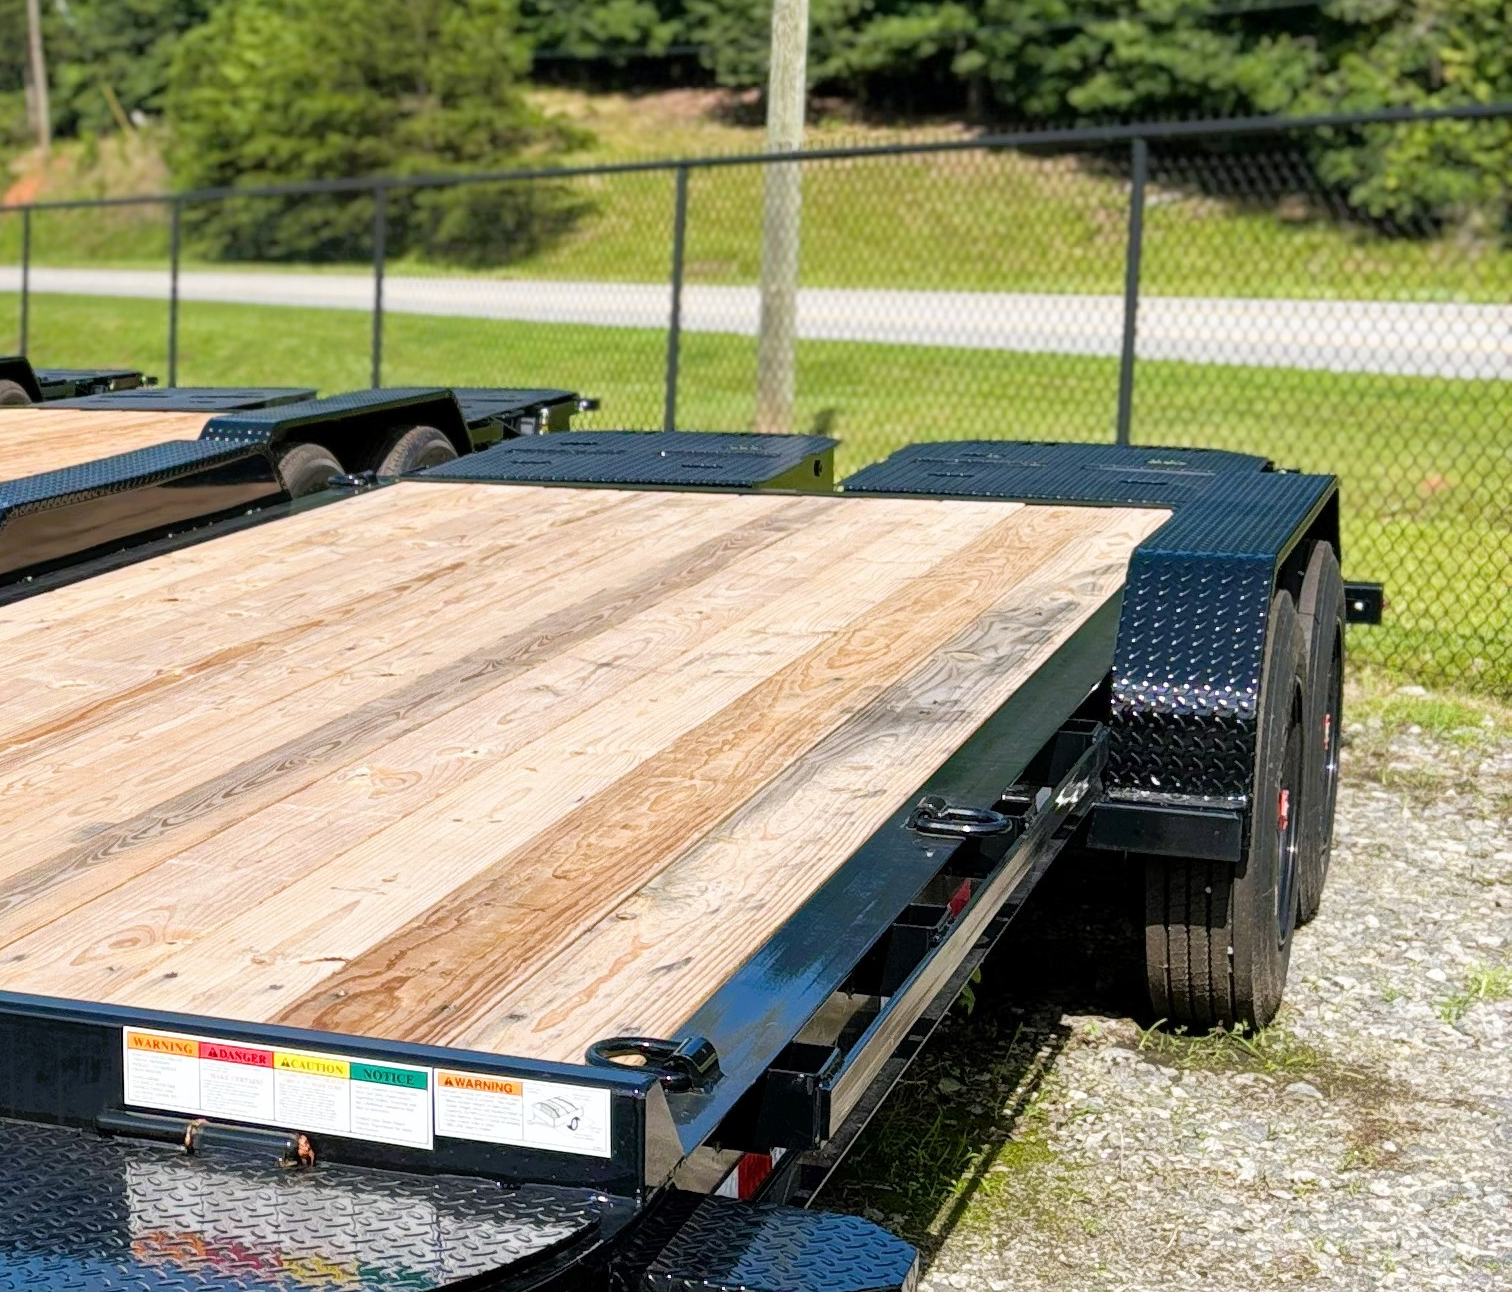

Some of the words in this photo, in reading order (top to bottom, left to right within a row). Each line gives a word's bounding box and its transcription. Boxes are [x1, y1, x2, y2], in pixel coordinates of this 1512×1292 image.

[133, 1037, 193, 1055] WARNING
[220, 1049, 267, 1064] DANGER
[290, 1060, 344, 1075] CAUTION
[362, 1068, 415, 1085] NOTICE
[455, 1077, 513, 1094] WARNING
